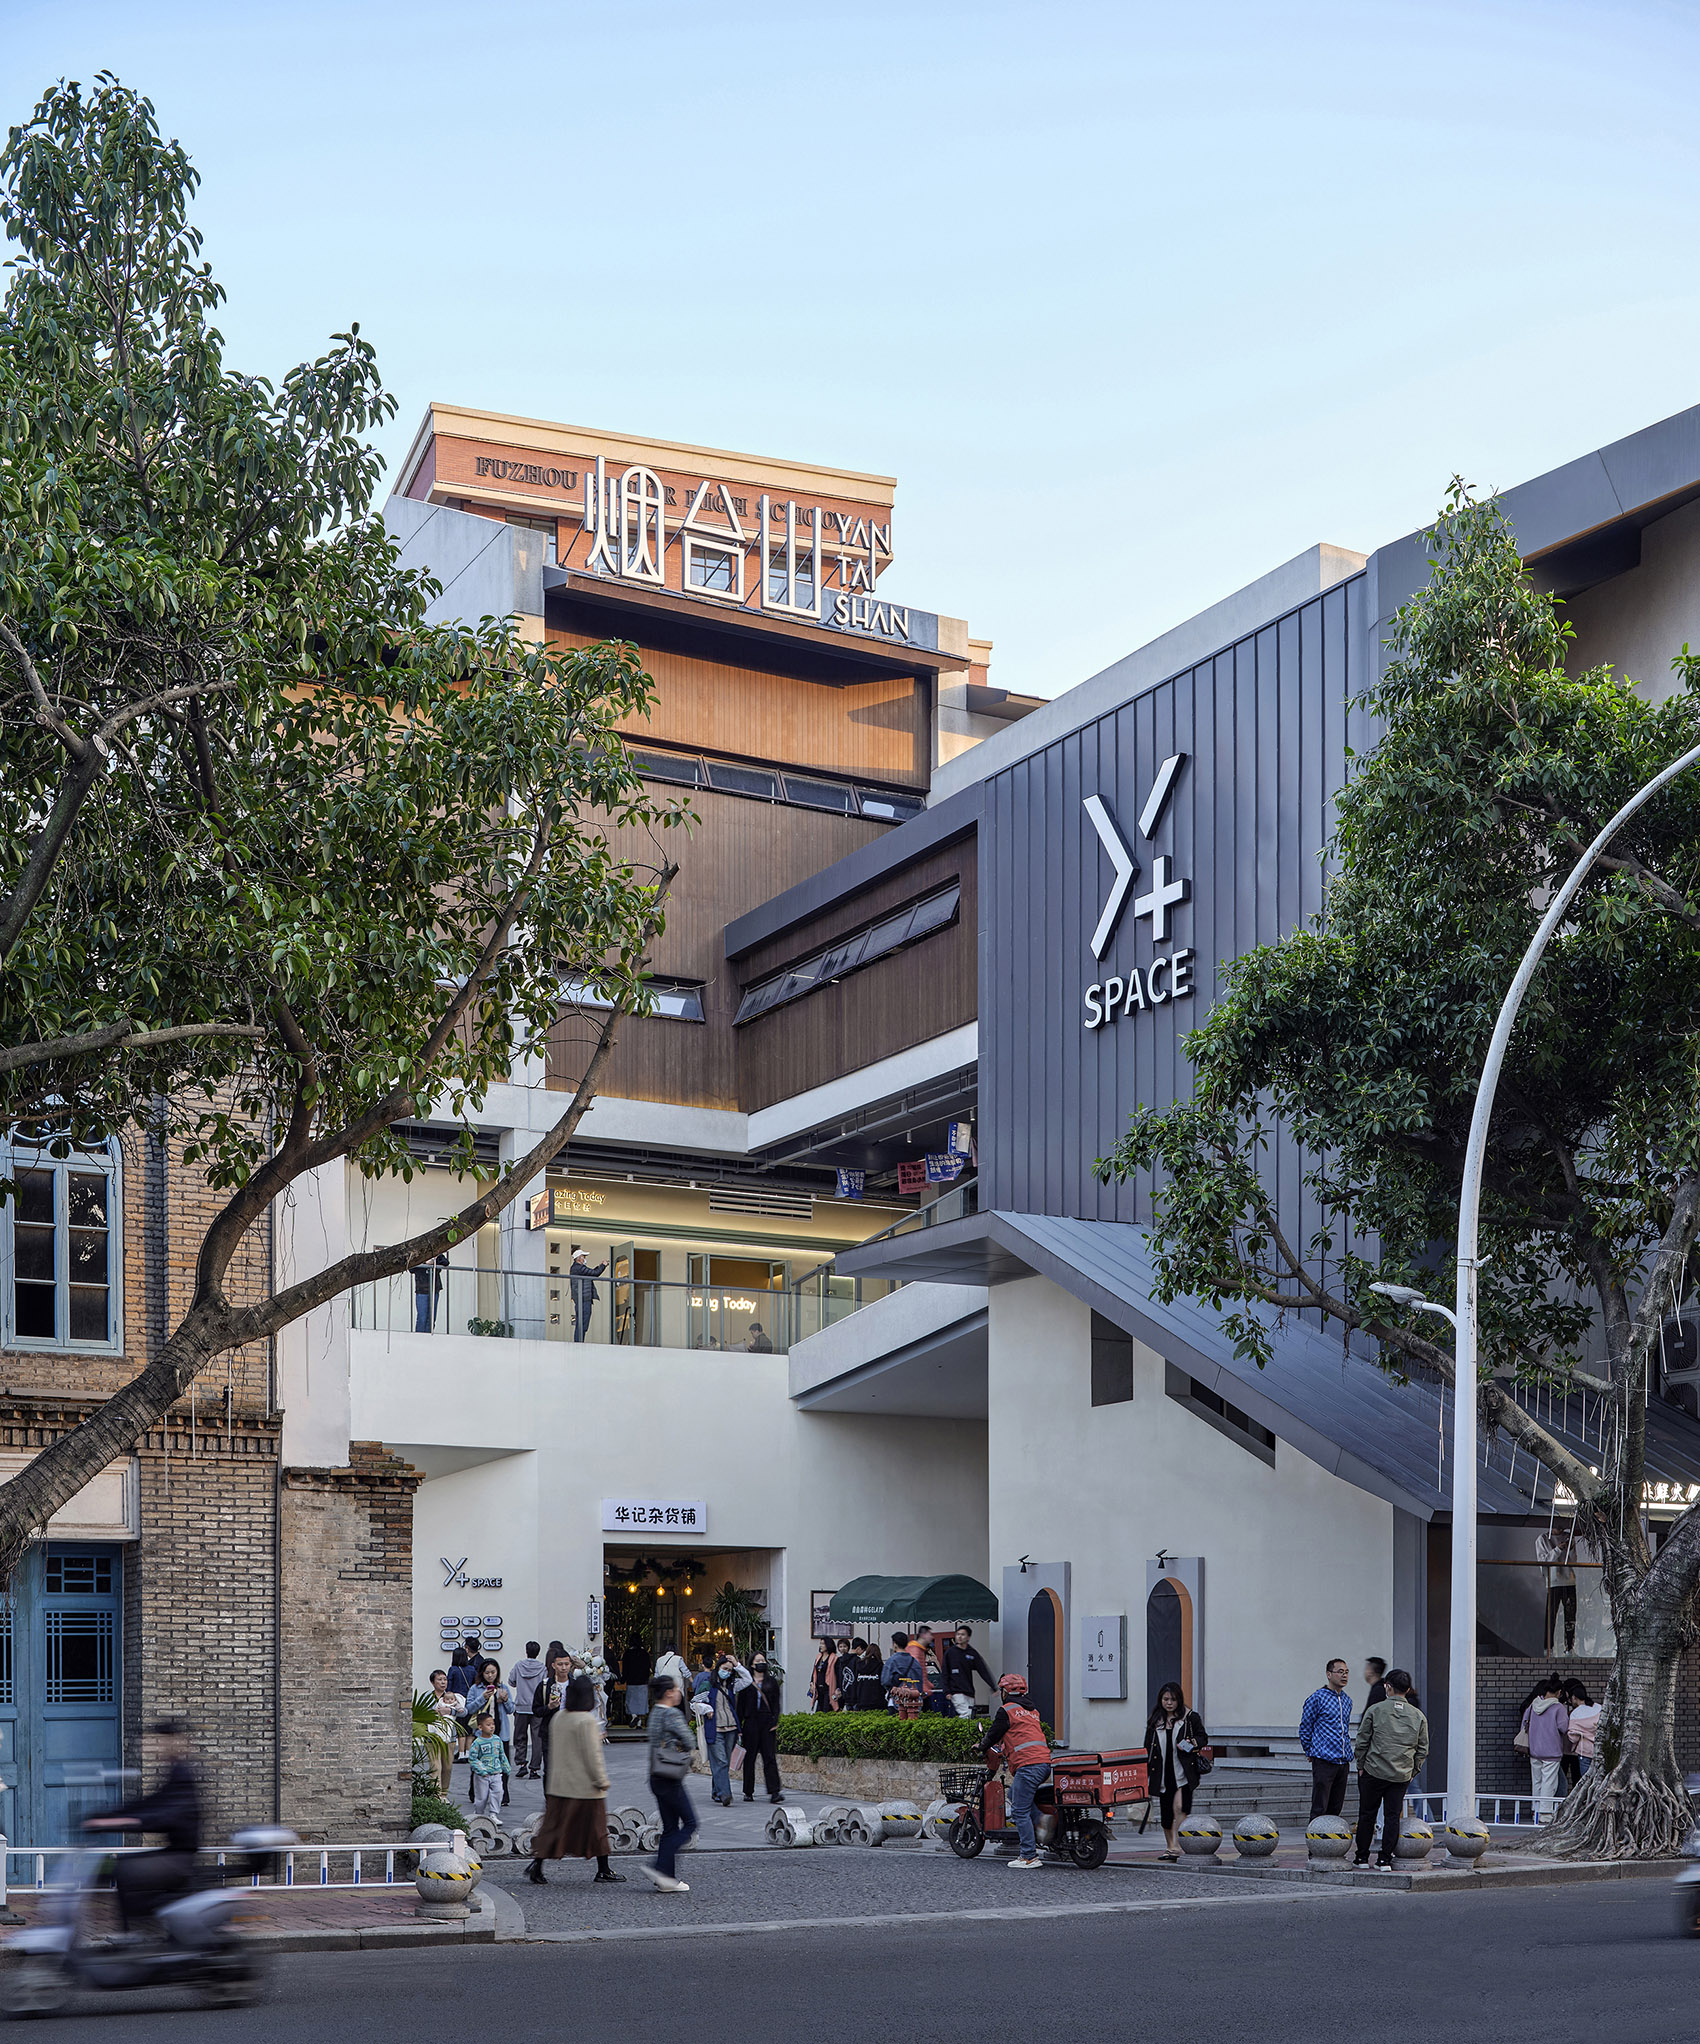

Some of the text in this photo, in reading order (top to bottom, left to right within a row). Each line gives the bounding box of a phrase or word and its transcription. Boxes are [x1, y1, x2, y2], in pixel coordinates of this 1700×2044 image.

[475, 456, 579, 490] FUZHOU
[835, 512, 890, 556] YAN
[834, 594, 909, 640] SHAN
[1083, 948, 1195, 1029] SPACE
[578, 1190, 606, 1205] Today
[723, 1296, 757, 1314] Today
[615, 1506, 696, 1525] 华记杂货铺
[471, 1577, 503, 1588] SPACE
